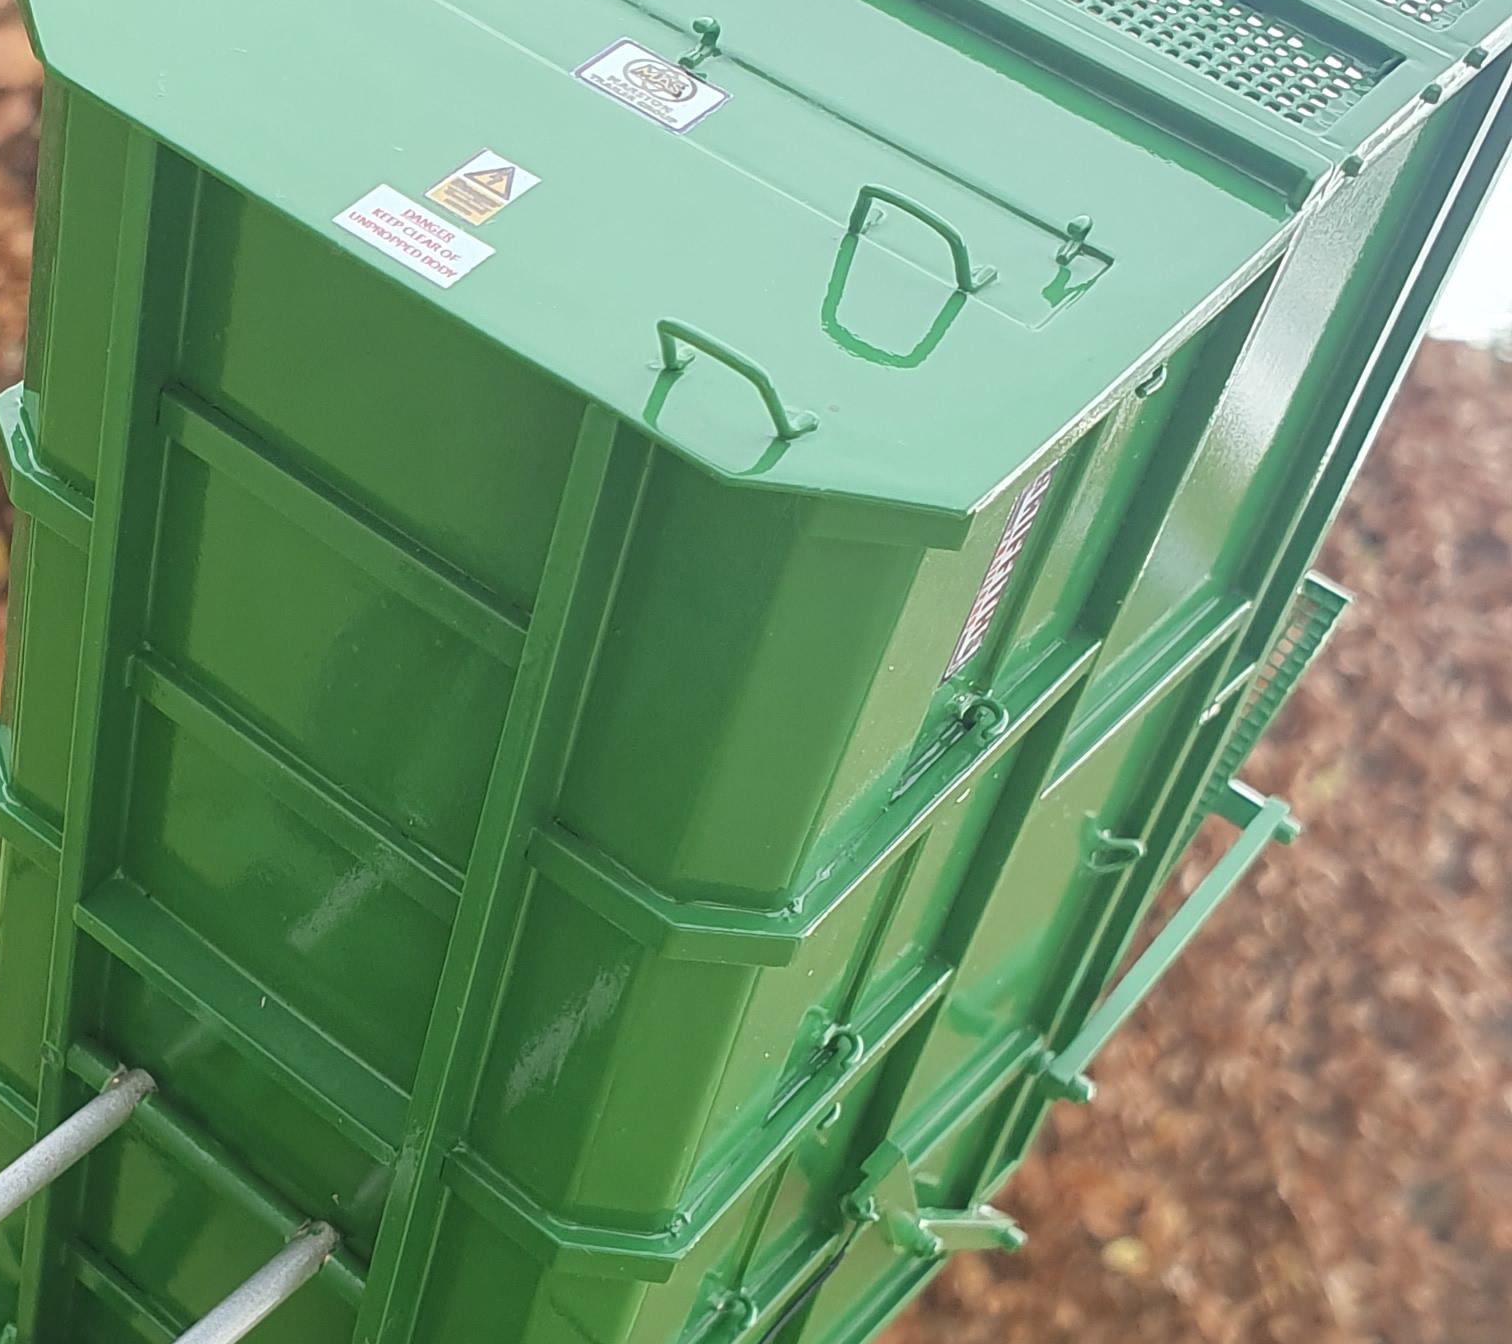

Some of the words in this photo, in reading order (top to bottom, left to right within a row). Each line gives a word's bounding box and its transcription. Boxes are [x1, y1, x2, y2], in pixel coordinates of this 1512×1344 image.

[637, 102, 678, 123] GROUP
[349, 211, 422, 258] UNPROPPED
[421, 255, 457, 278] BODY
[372, 208, 404, 227] KEEP
[403, 226, 441, 252] CLEAR
[440, 249, 461, 261] OF
[400, 209, 455, 242] DANGER
